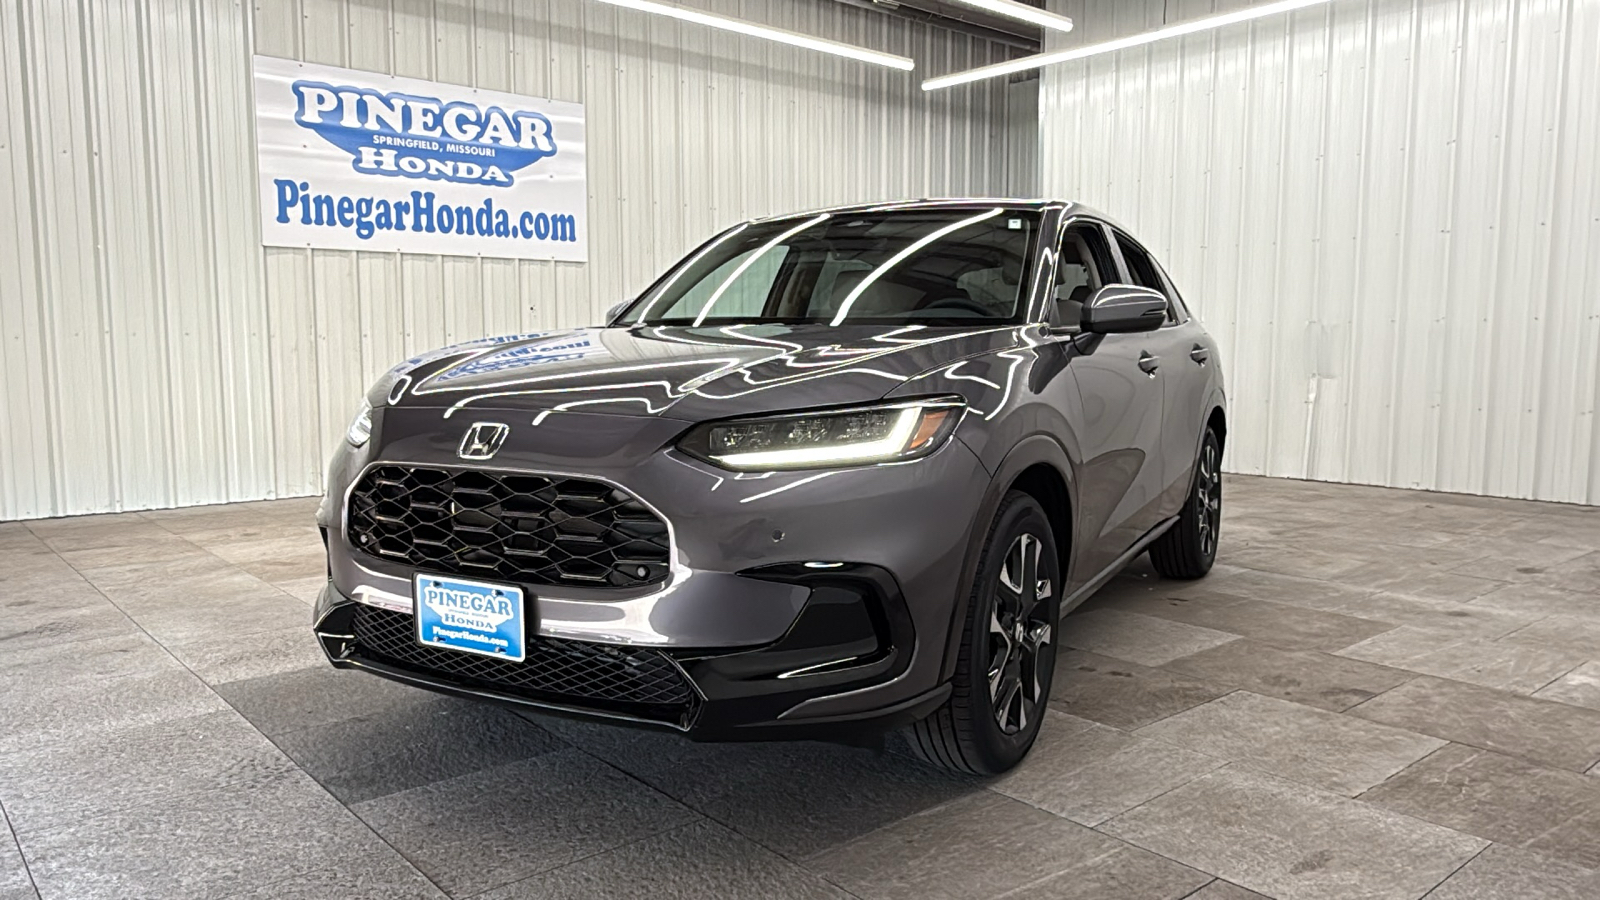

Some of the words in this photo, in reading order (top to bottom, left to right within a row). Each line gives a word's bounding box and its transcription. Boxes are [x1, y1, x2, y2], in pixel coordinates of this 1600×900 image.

[298, 86, 553, 151] PINEGAR
[372, 134, 443, 152] SPRINGFIELD,
[446, 143, 496, 157] MISSOURI
[358, 146, 509, 182] HONDA
[274, 178, 577, 242] PinegarHonda.com
[427, 590, 511, 616] PINEGAR
[444, 613, 494, 630] HONDA
[432, 625, 509, 647] PinegarHonda.com
